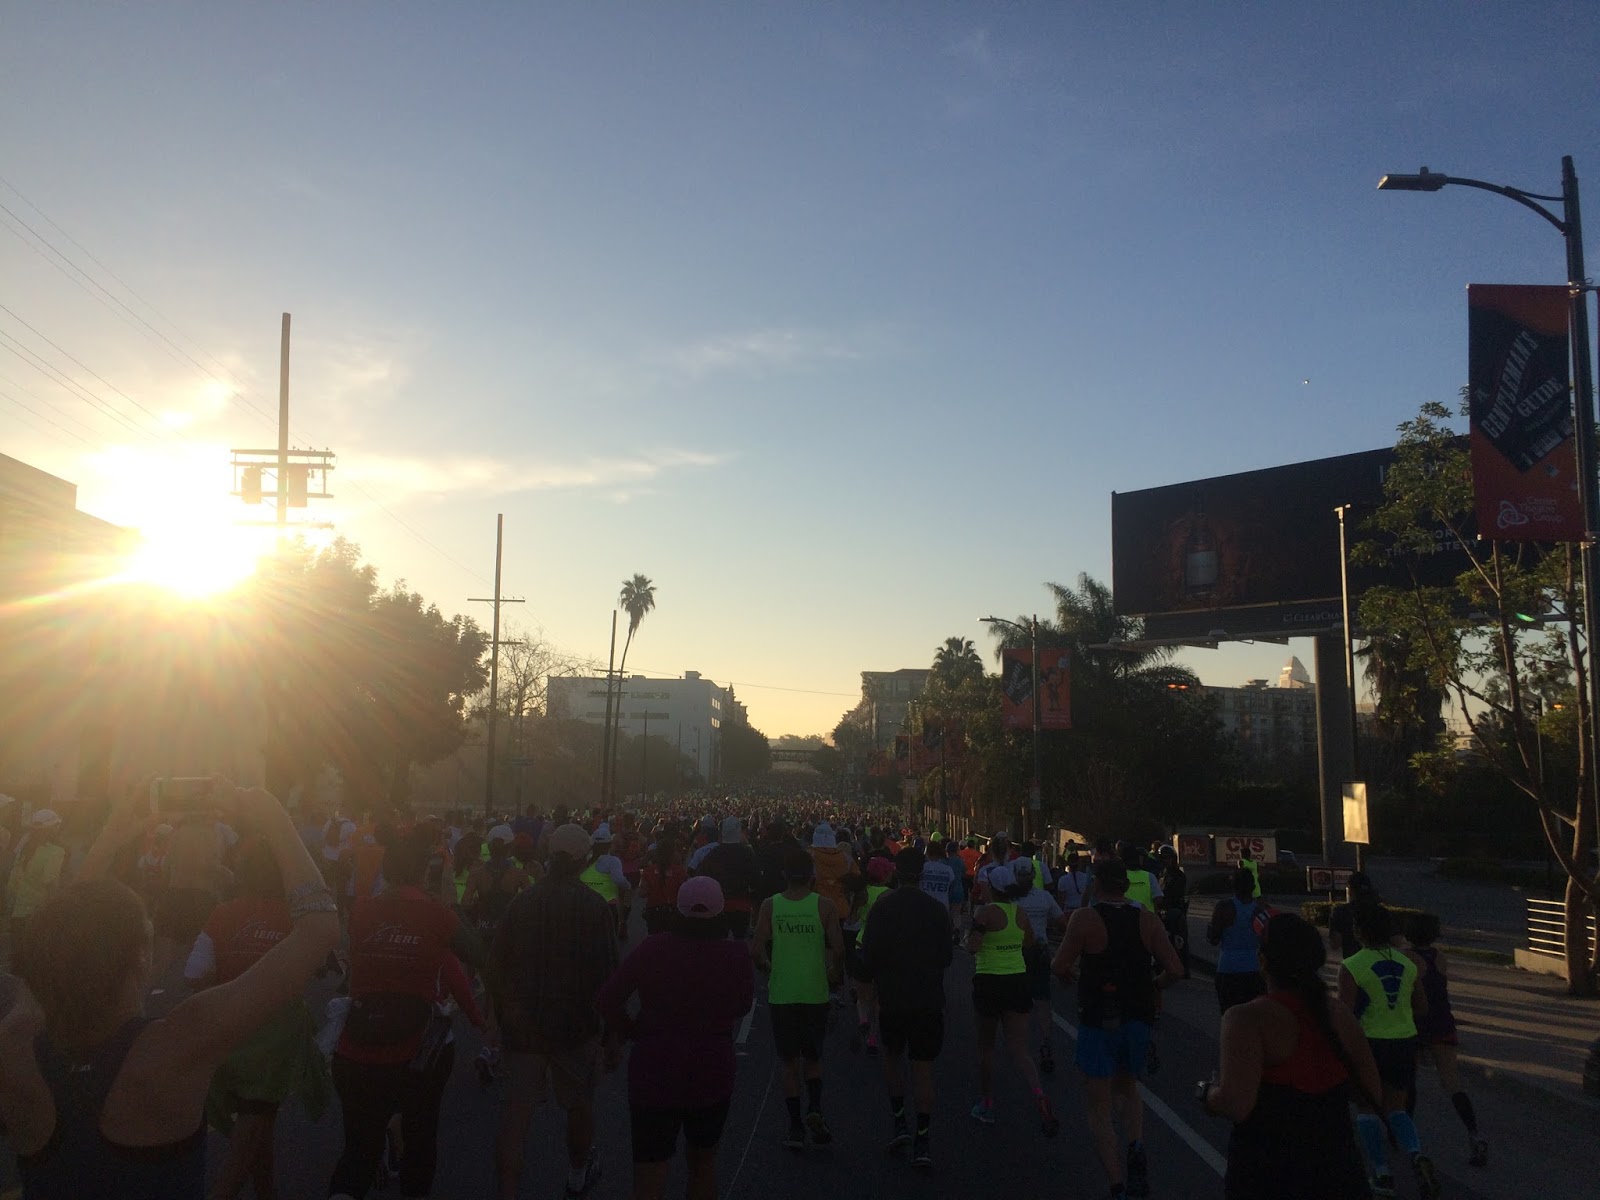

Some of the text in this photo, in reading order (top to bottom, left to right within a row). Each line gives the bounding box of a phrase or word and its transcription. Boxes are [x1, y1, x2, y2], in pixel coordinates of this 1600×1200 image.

[1516, 376, 1564, 417] GUIDE
[1226, 838, 1264, 852] CVS
[1226, 853, 1265, 861] phaacy
[921, 881, 948, 892] LIVES
[784, 921, 816, 933] Aetna
